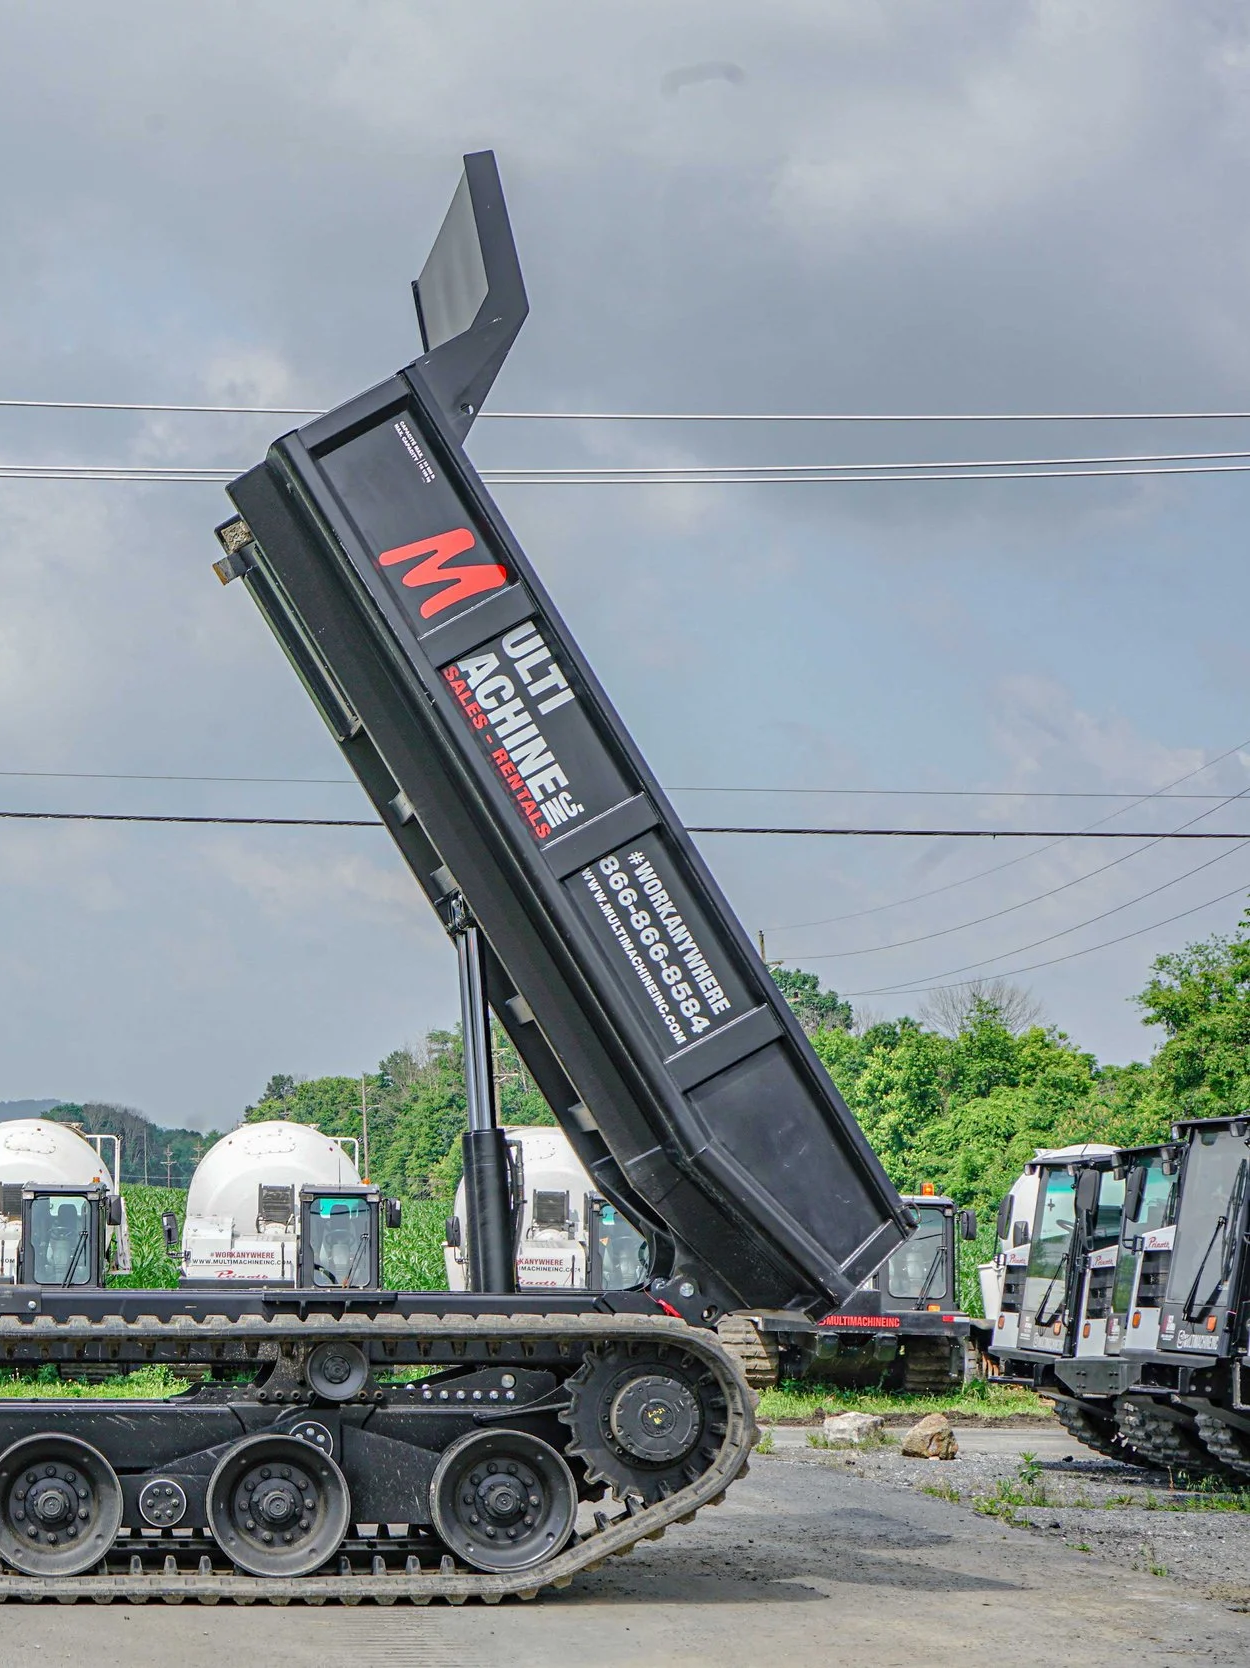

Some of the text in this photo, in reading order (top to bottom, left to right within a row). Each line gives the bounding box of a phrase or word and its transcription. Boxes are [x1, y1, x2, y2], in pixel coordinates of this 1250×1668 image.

[444, 665, 488, 729] SALES
[492, 747, 551, 839] RENTALS
[581, 867, 687, 1045] WWW.MULTIMACHINEINC.COM
[599, 855, 711, 1034] 866-866-8584
[627, 851, 731, 1015] #WORKANYWHERE
[517, 1258, 564, 1266] KANYWHERE
